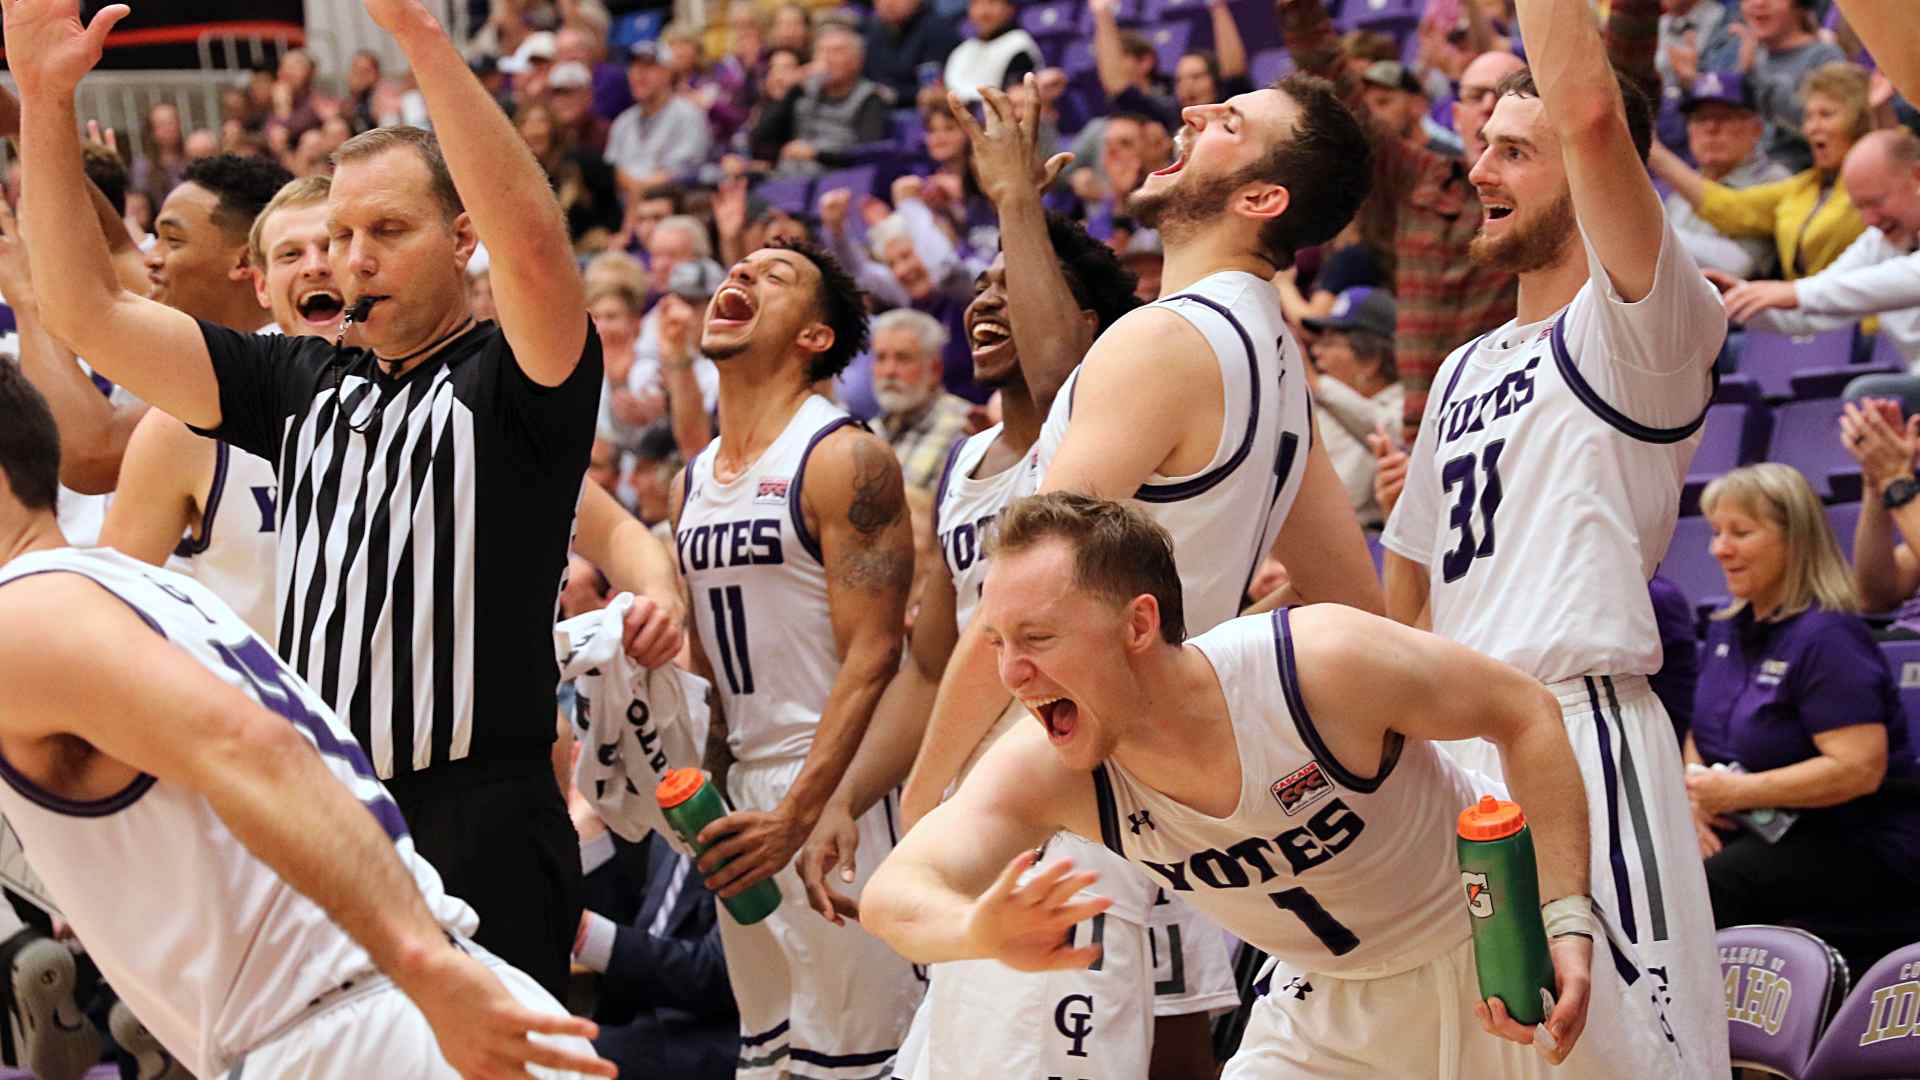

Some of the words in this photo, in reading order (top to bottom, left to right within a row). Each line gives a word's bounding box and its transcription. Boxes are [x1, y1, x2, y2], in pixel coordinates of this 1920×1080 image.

[677, 519, 784, 576] YOTES
[1442, 438, 1503, 584] 31
[709, 585, 755, 695] 11
[1141, 797, 1365, 892] YOTES
[1268, 886, 1361, 957] 1
[1725, 965, 1792, 1035] AHO
